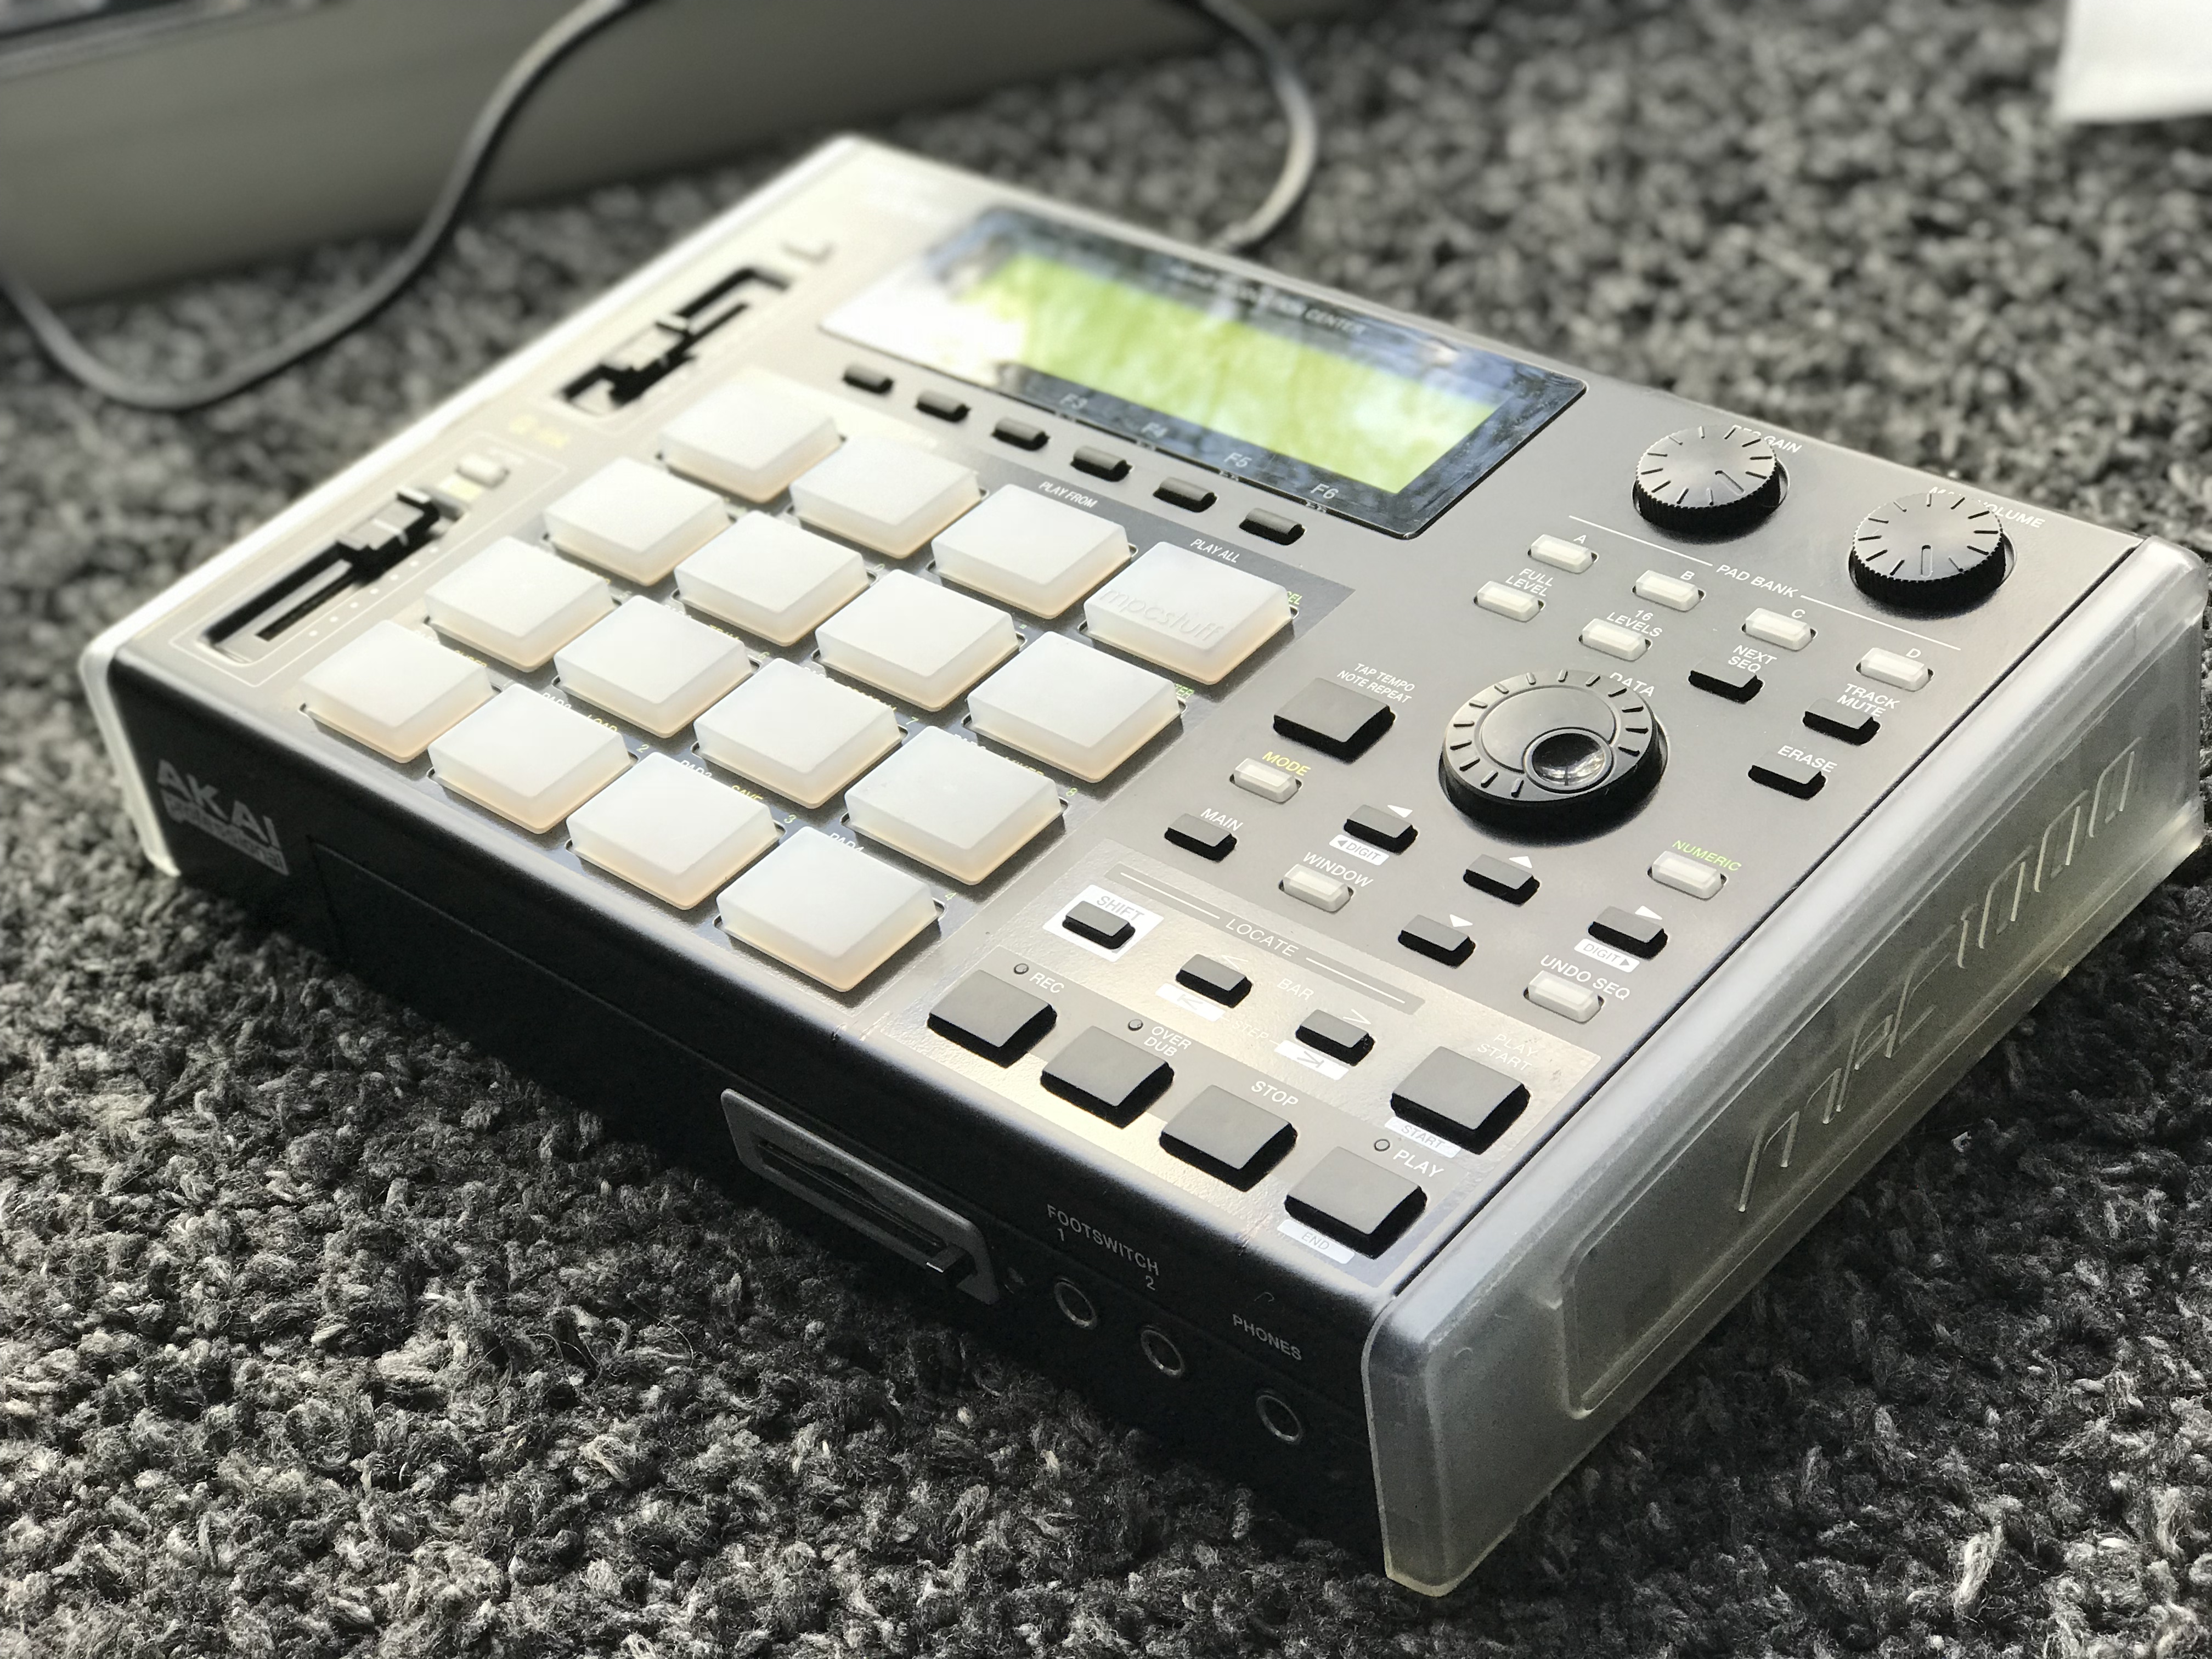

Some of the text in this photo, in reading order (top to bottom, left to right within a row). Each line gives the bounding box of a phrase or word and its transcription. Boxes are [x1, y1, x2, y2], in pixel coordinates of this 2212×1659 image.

[1059, 393, 1088, 409] F3
[1141, 422, 1168, 437] F4
[1764, 436, 1802, 453] GAIN
[1223, 452, 1252, 469] F5
[1039, 482, 1098, 509] PLAY FROM
[1310, 483, 1339, 500] F6
[1974, 501, 2045, 528] OLUME
[1573, 534, 1586, 544] A
[1190, 539, 1240, 563] PLAY ALL
[1505, 577, 1547, 597] LEVEL
[1519, 568, 1553, 586] FULL
[1680, 571, 1695, 580] B
[1716, 565, 1799, 599] PAD BANK
[1099, 588, 1223, 641] mpcstuff
[1606, 612, 1662, 637] LEVELS
[1635, 610, 1654, 621] 16
[1791, 610, 1805, 618] C
[1733, 645, 1777, 665] NEXT
[1906, 648, 1922, 658] D
[1728, 656, 1762, 674] SEQ
[1336, 670, 1412, 703] NOTE REPEAT
[1355, 663, 1415, 692] TAP TEMPO
[1610, 673, 1654, 697] DATA
[1837, 695, 1886, 717] MUTE
[1845, 684, 1900, 709] TRACK
[906, 716, 919, 725] 7
[636, 744, 650, 753] 2
[1778, 745, 1837, 772] ERASE
[1262, 752, 1311, 776] MODE
[1066, 788, 1077, 796] 8
[156, 759, 280, 850] AKAI
[784, 815, 797, 823] 3
[1200, 808, 1243, 831] MAIN
[1346, 842, 1381, 862] DIGIT
[1672, 840, 1742, 872] NUMERIC
[1303, 852, 1374, 887] WINDOW
[1096, 895, 1145, 921] SHIFT
[1226, 919, 1299, 957] LOCATE
[1583, 943, 1620, 966] DIGIT
[1029, 972, 1064, 994] REC
[1277, 978, 1314, 1000] BAR
[1541, 955, 1630, 1001] UNDO SEQ
[1152, 1026, 1192, 1050] OVER
[1232, 1020, 1269, 1041] STEP
[1143, 1036, 1177, 1057] DUB
[1477, 1043, 1532, 1070] START
[1493, 1033, 1538, 1057] PLAY
[1251, 1081, 1299, 1107] STOP
[1401, 1125, 1446, 1149] START
[1393, 1149, 1444, 1178] PLAY
[1046, 1204, 1159, 1276] FOOTSWITCH
[1057, 1228, 1064, 1241] 1
[1301, 1232, 1330, 1251] END
[1146, 1275, 1155, 1290] 2
[1232, 1314, 1302, 1361] PHONES
